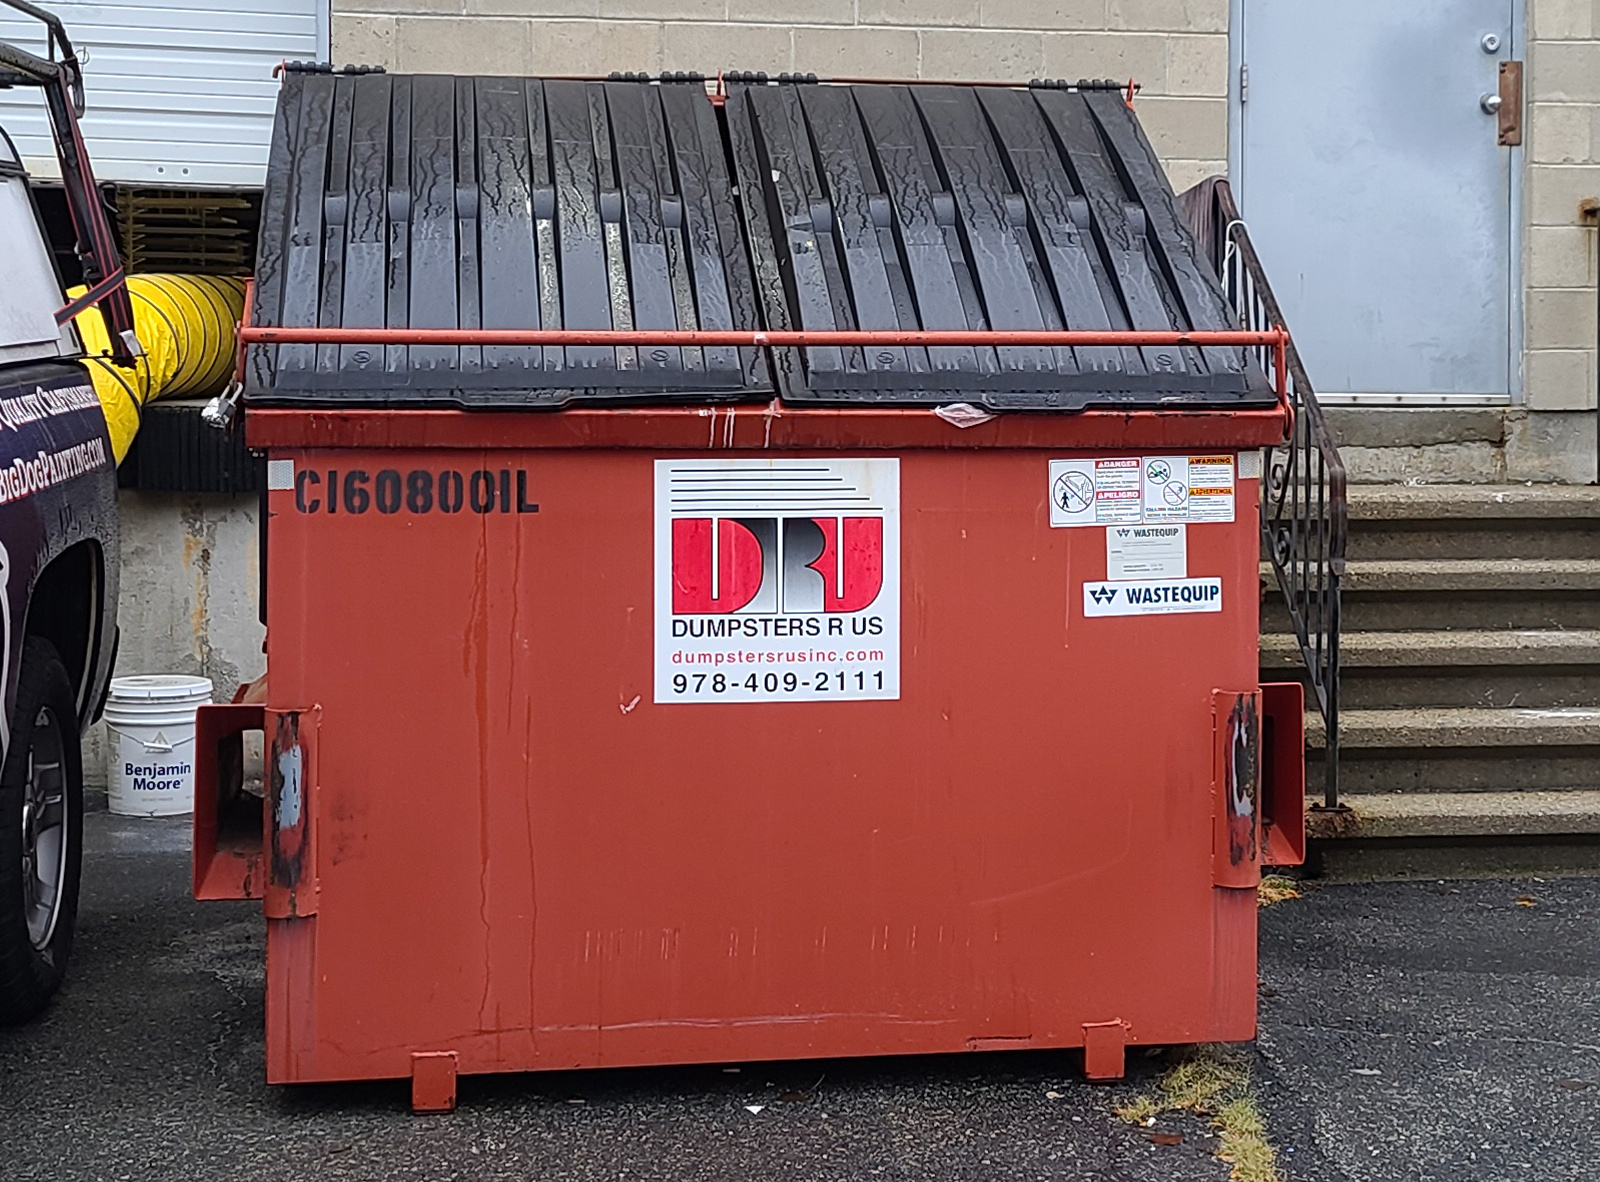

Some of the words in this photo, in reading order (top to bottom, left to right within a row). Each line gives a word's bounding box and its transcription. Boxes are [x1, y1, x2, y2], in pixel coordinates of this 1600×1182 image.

[1104, 460, 1138, 468] DANGER
[1194, 457, 1231, 465] WARNING
[1104, 491, 1139, 499] PELIGRO
[1133, 528, 1179, 537] WASTEQUIP
[1126, 585, 1219, 605] WASTEQUIP
[672, 618, 820, 638] DUMPSTERS
[828, 617, 843, 636] R
[852, 616, 883, 636] US
[672, 648, 884, 666] dumpstersrusinc.com
[673, 671, 884, 694] 978-409-2111
[125, 761, 191, 779] Benjamin
